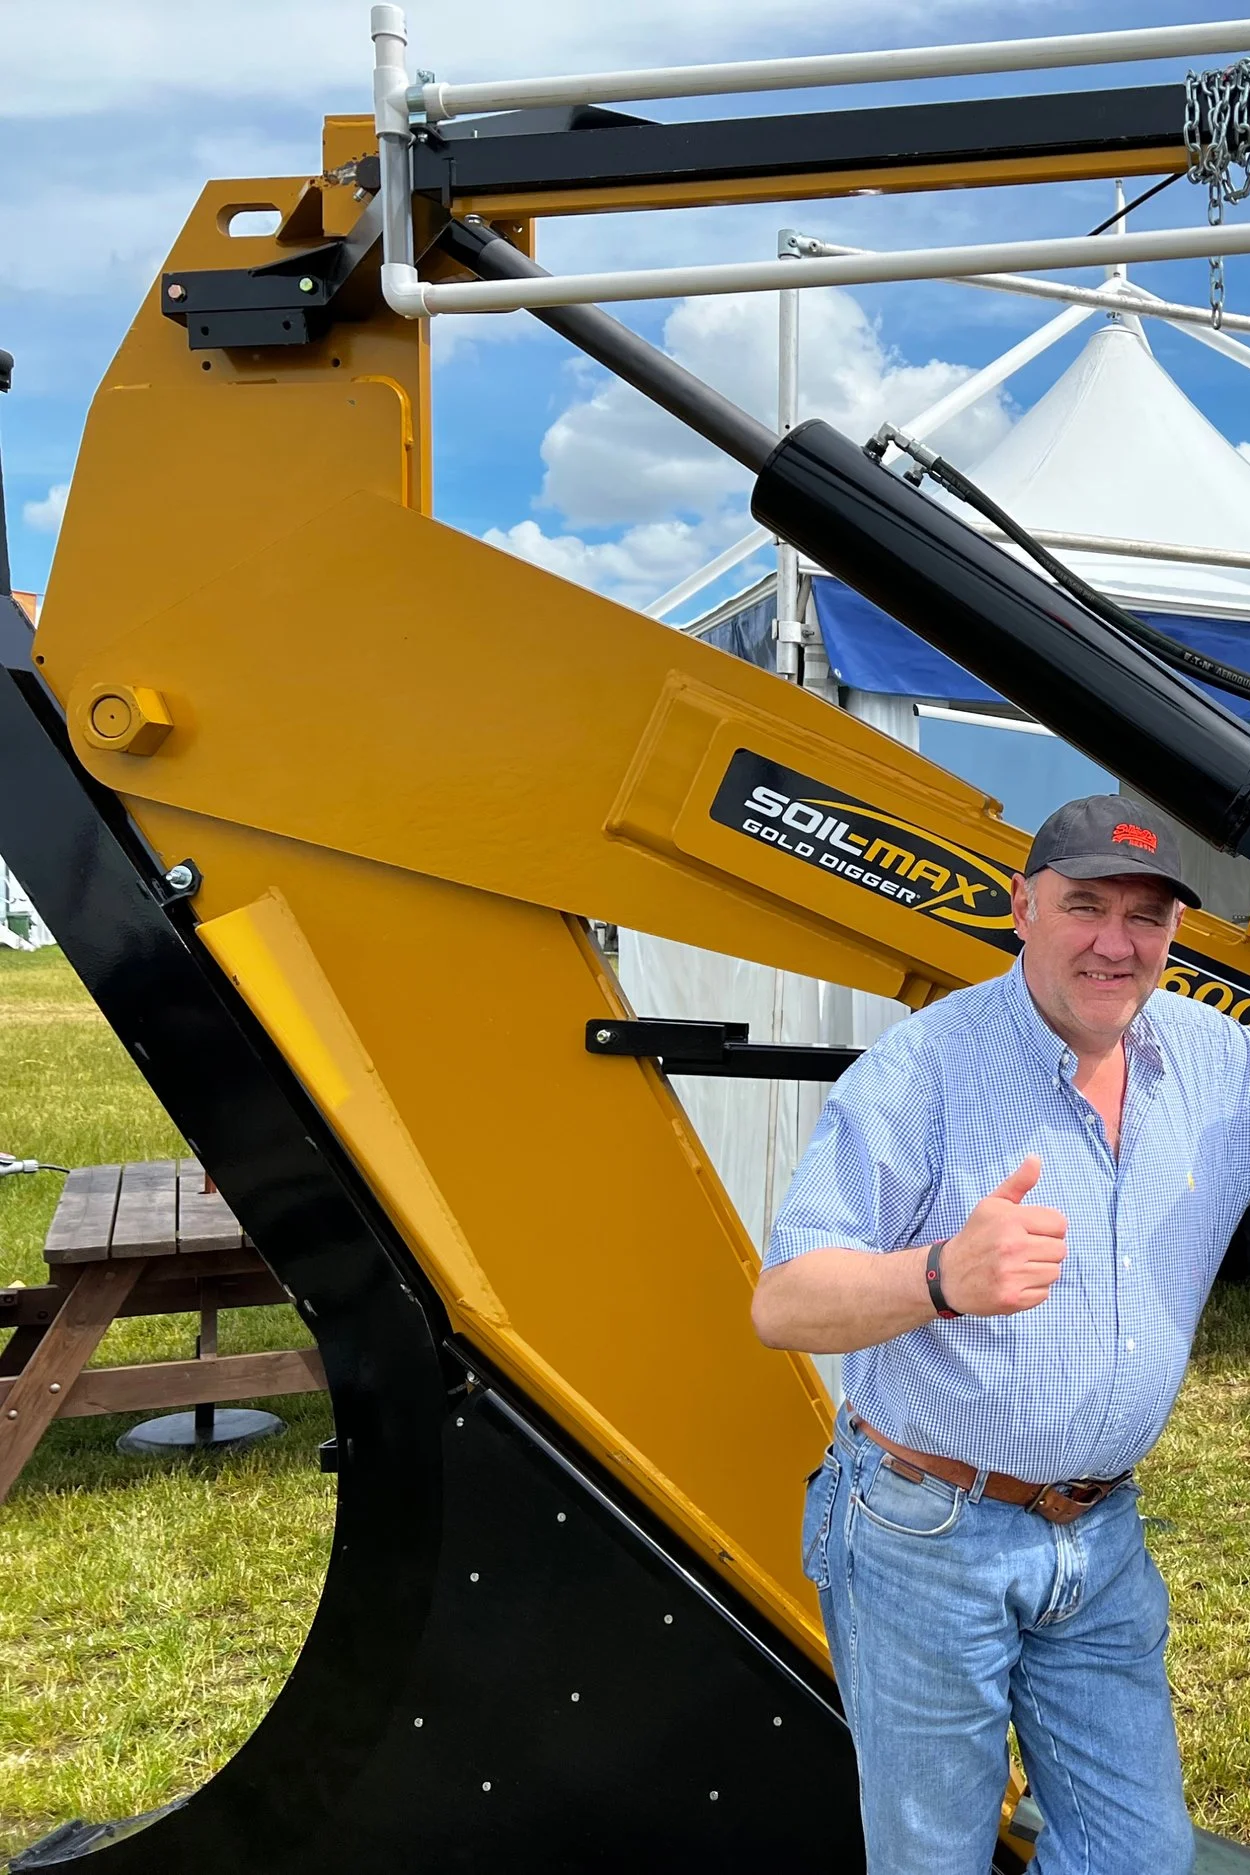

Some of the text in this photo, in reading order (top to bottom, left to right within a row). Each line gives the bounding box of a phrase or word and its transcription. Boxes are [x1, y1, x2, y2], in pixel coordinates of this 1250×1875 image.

[742, 819, 913, 903] GOLD DIGGER
[744, 786, 989, 910] SOIL-MAX
